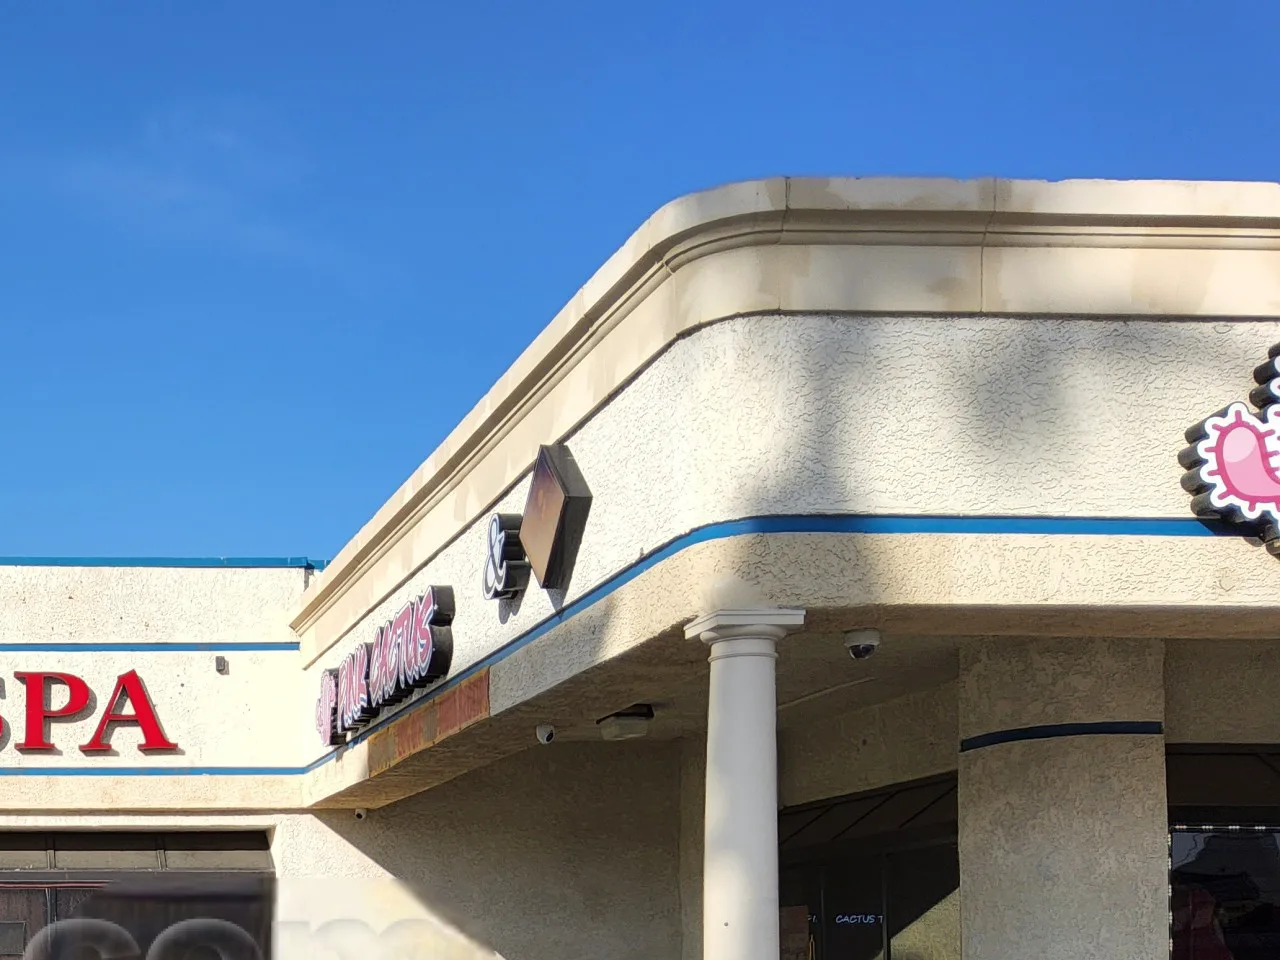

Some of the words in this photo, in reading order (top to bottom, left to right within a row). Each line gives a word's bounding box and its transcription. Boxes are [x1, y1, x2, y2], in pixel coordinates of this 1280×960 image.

[337, 643, 369, 734] PINK
[370, 585, 437, 707] CACTUS
[835, 914, 876, 924] CACTUS
